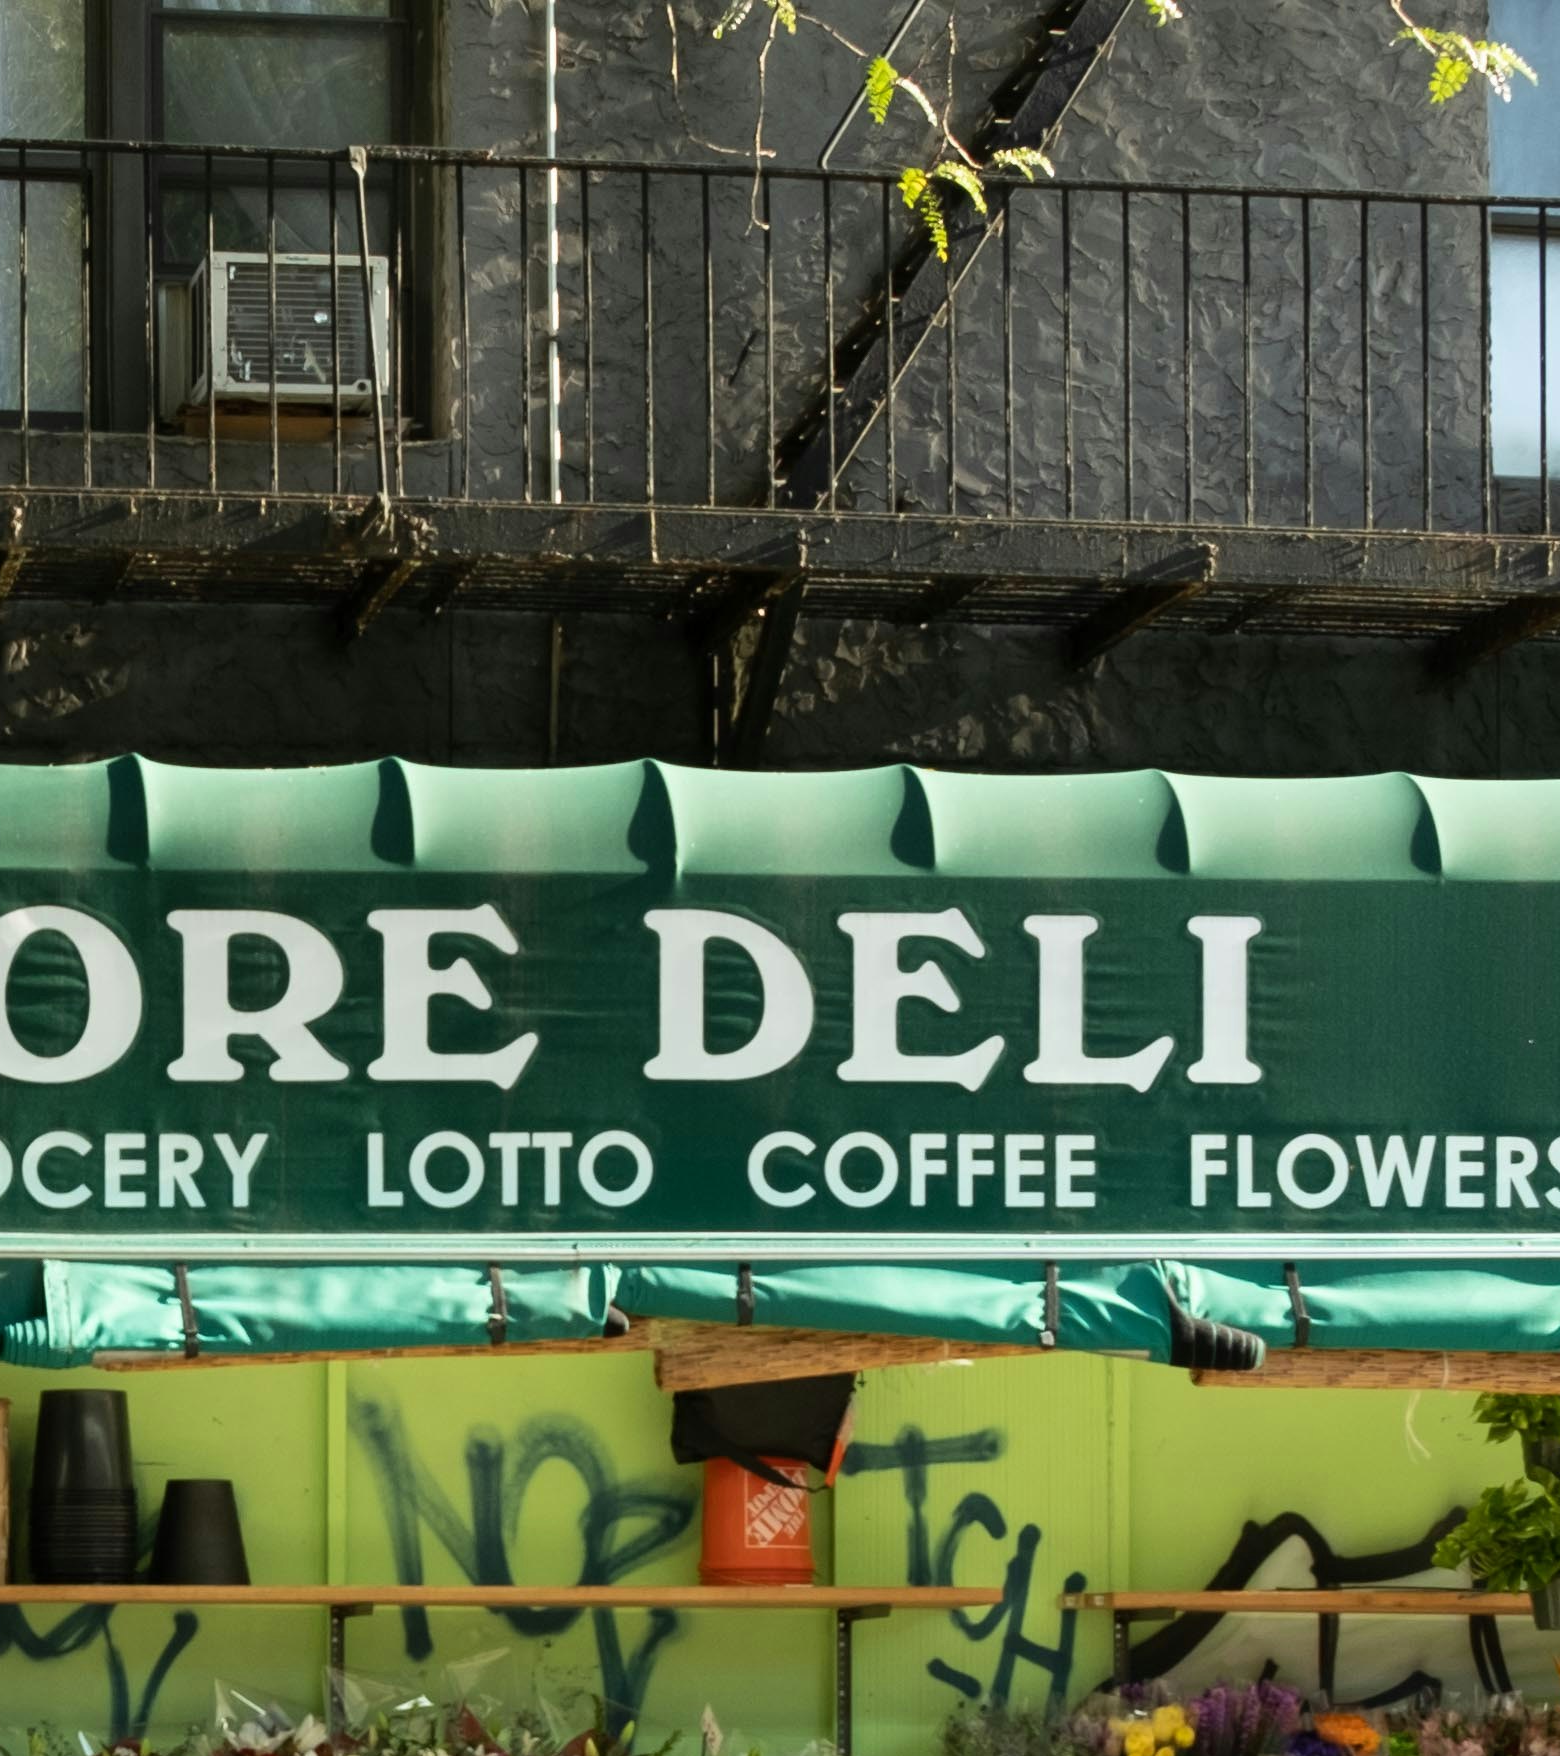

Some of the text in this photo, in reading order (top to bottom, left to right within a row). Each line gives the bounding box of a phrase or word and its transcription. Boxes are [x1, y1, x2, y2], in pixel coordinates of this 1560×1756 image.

[644, 907, 1263, 1092] DELI
[367, 1130, 654, 1208] LOTTO
[747, 1131, 1097, 1208] COFFEE
